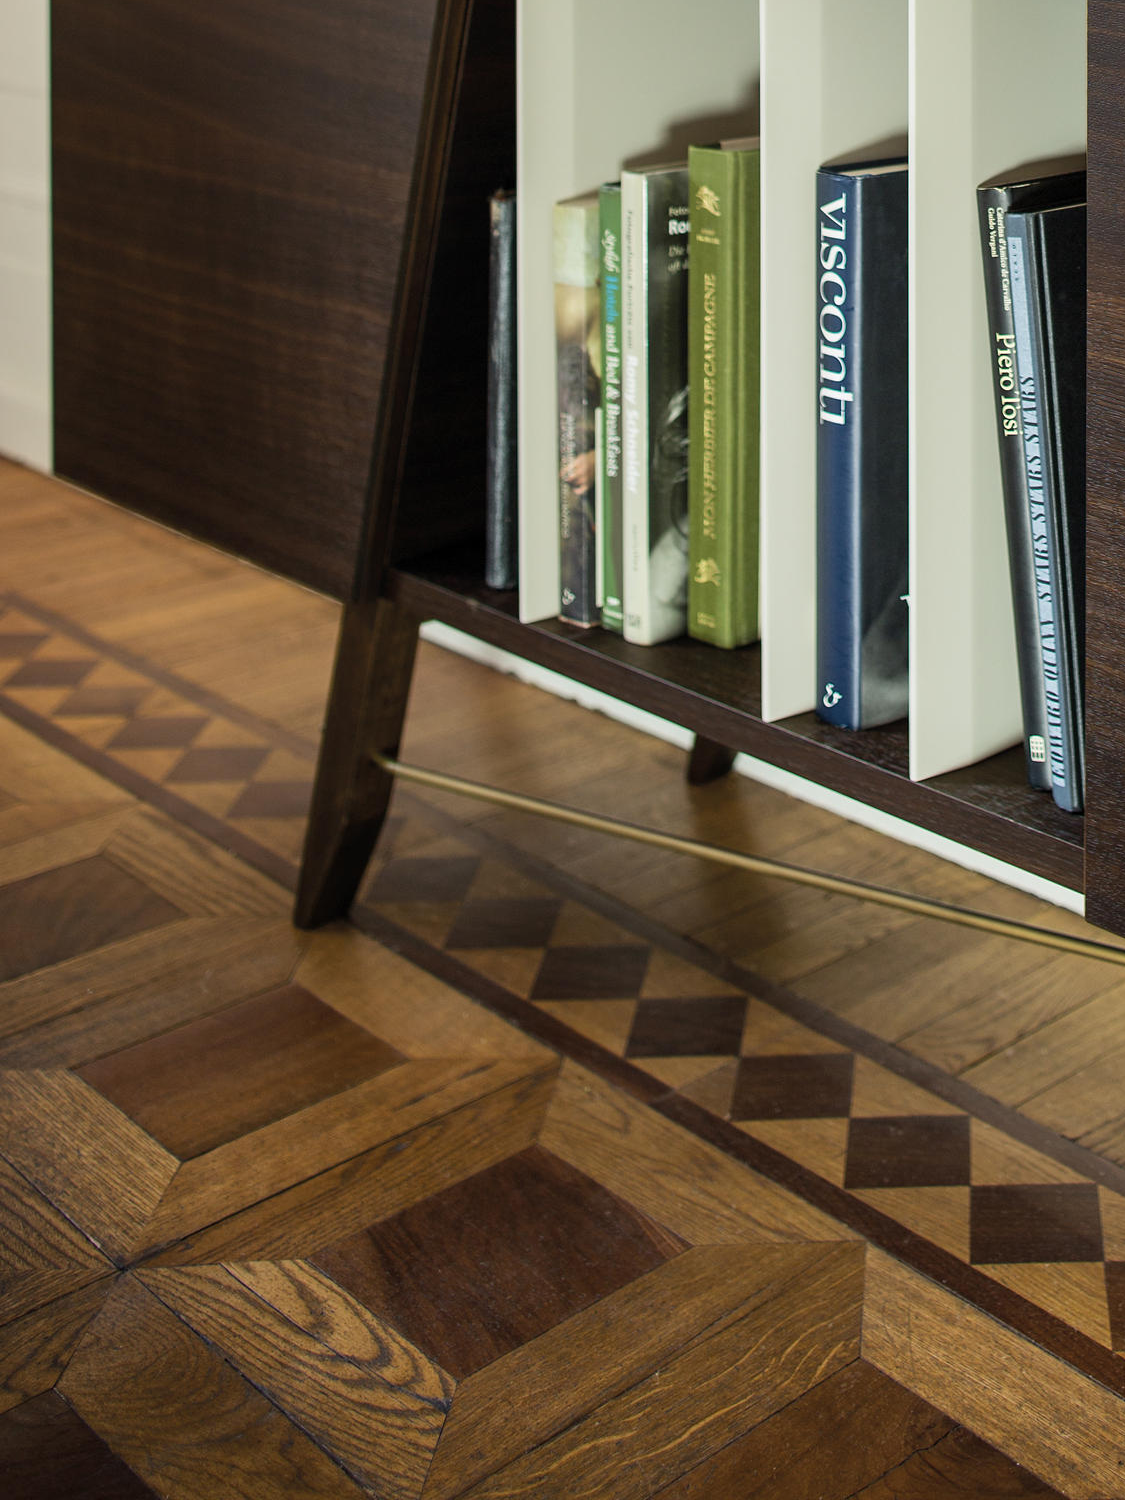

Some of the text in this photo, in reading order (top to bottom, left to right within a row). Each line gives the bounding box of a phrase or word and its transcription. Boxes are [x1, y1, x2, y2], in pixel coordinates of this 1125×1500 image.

[987, 207, 999, 258] Guido Vergani
[605, 275, 619, 323] Hotels
[819, 192, 854, 426] visconti
[605, 324, 620, 354] and
[605, 355, 620, 385] Bed
[605, 384, 620, 400] &
[703, 273, 717, 540] MON HERBIER DE CAMPAGNE
[995, 332, 1024, 437] Piero Tosi
[1019, 375, 1041, 444] STARS
[605, 402, 621, 478] Breakfasts
[624, 355, 640, 494] Romy Schneider
[1026, 455, 1046, 523] STARS
[1033, 532, 1053, 602] STARS
